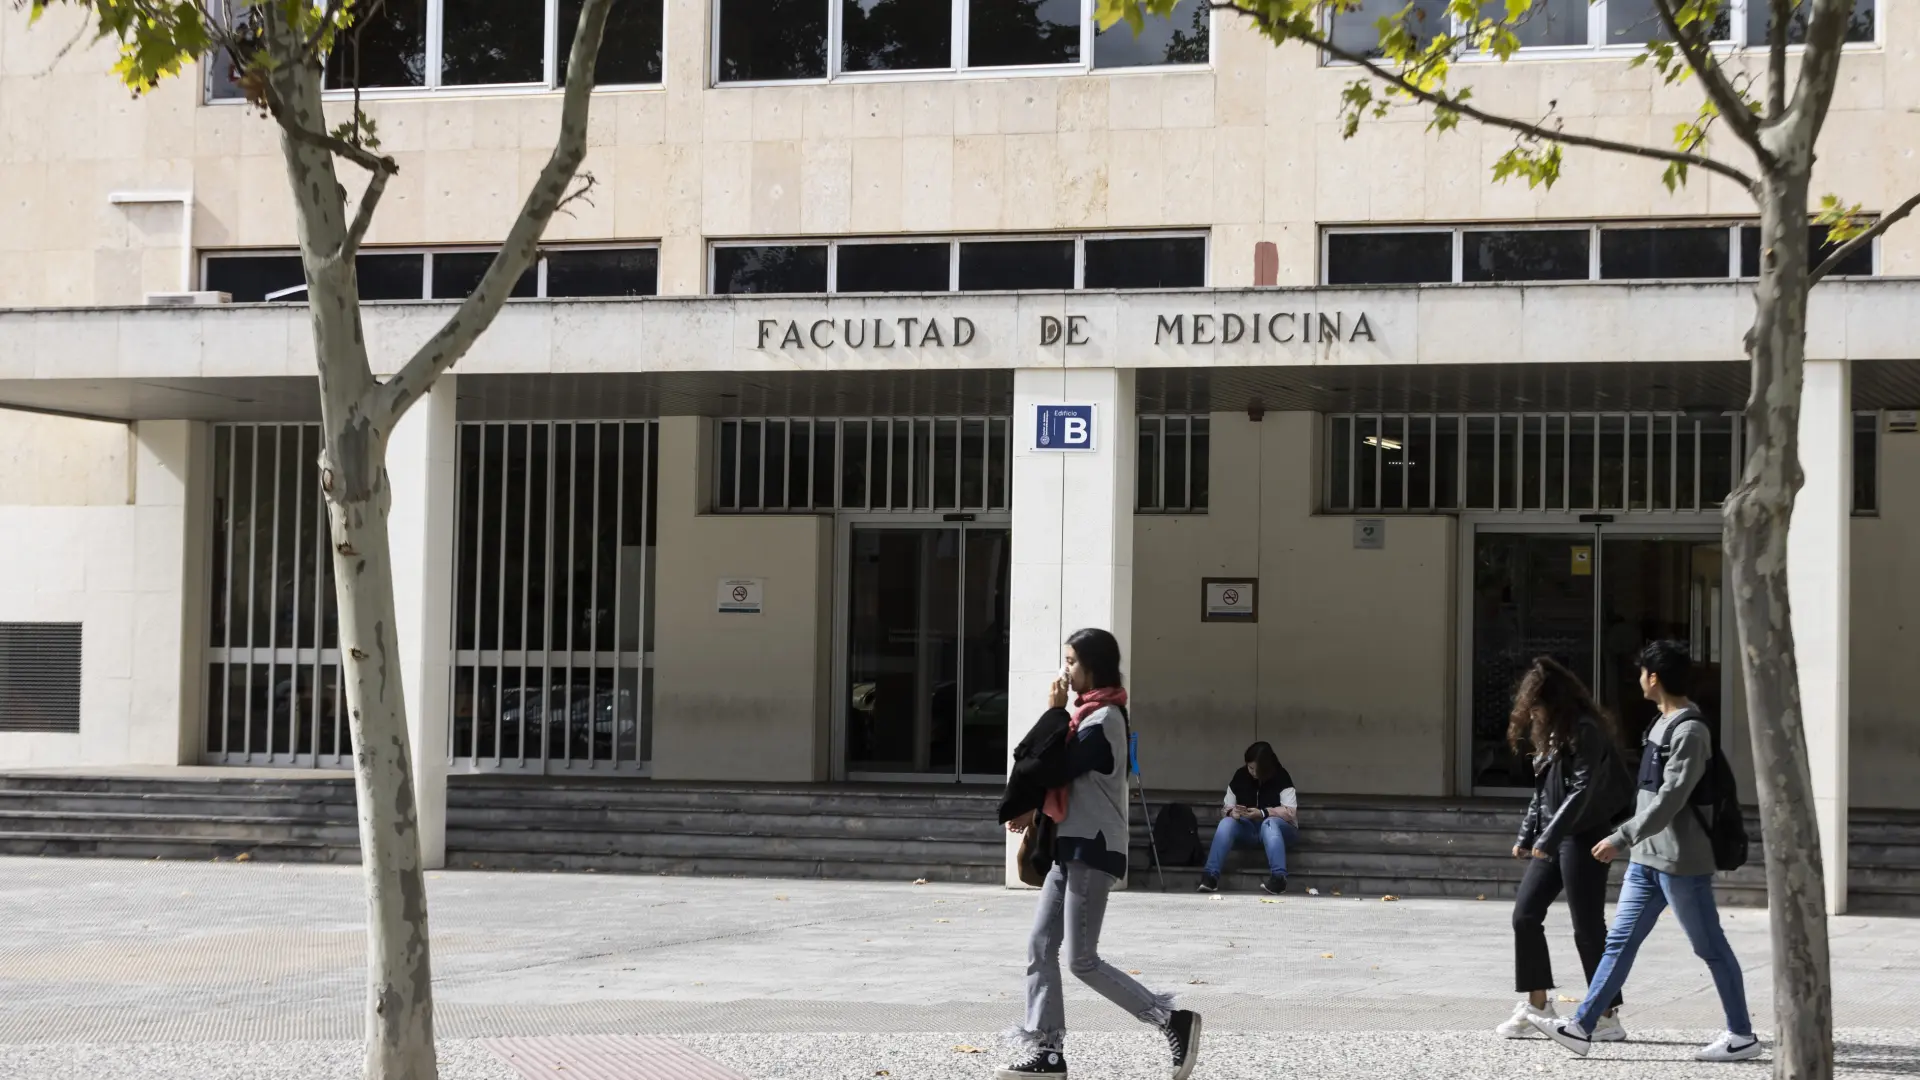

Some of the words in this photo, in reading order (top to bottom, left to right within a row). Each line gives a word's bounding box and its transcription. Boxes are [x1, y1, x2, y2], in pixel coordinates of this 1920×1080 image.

[756, 316, 976, 349] FACULTAD
[1039, 315, 1090, 346] DE
[1153, 311, 1376, 345] MEDICINA
[1054, 409, 1078, 417] Edificio
[1064, 417, 1088, 444] B
